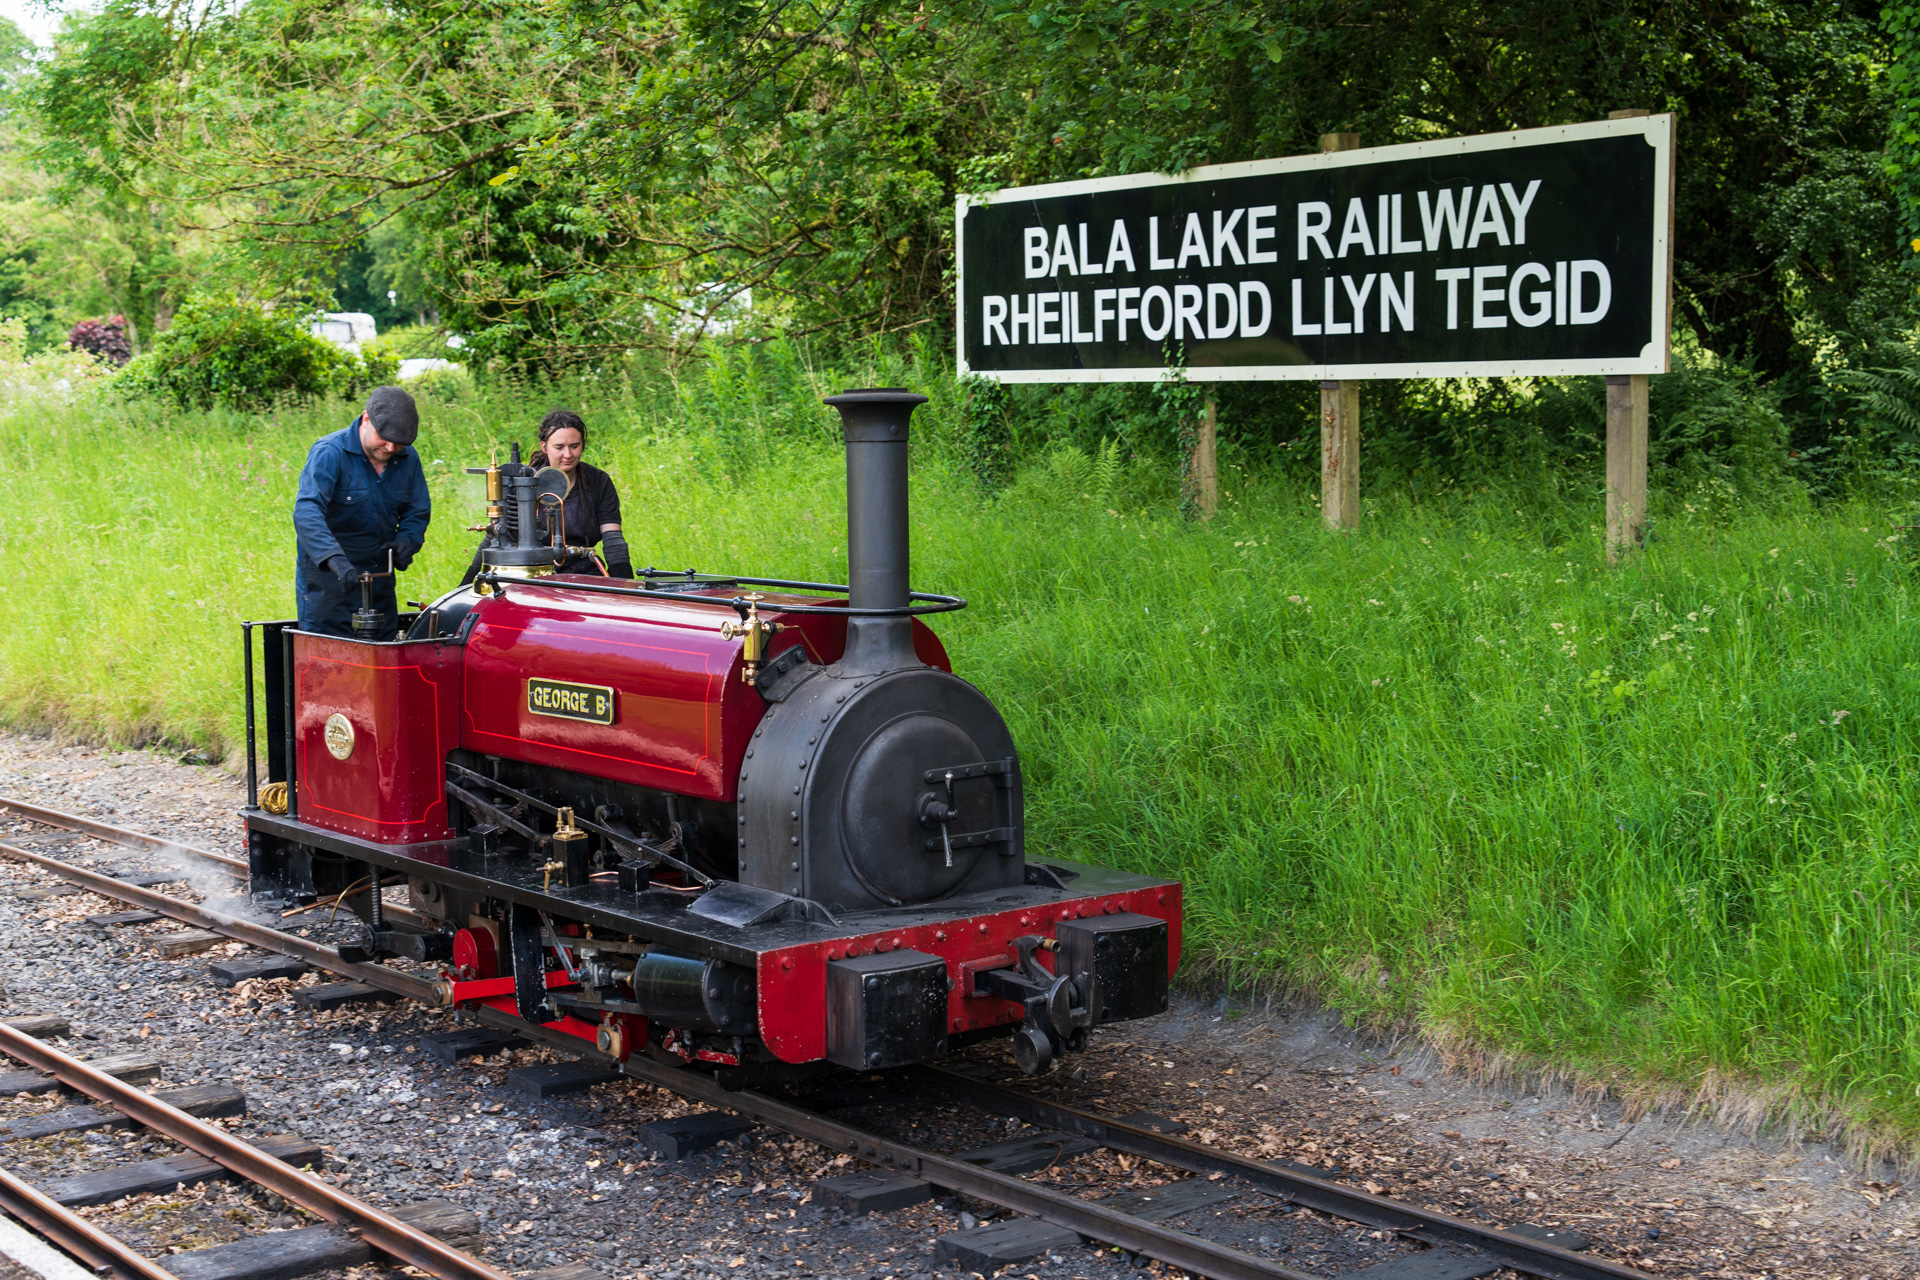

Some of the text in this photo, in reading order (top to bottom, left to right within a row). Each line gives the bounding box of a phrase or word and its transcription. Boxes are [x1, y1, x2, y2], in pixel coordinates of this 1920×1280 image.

[1024, 179, 1542, 279] BALA LAKE RAILWAY
[982, 259, 1612, 346] RHEILFFORDD LLYN TEGID
[534, 687, 606, 716] GEORGE B
